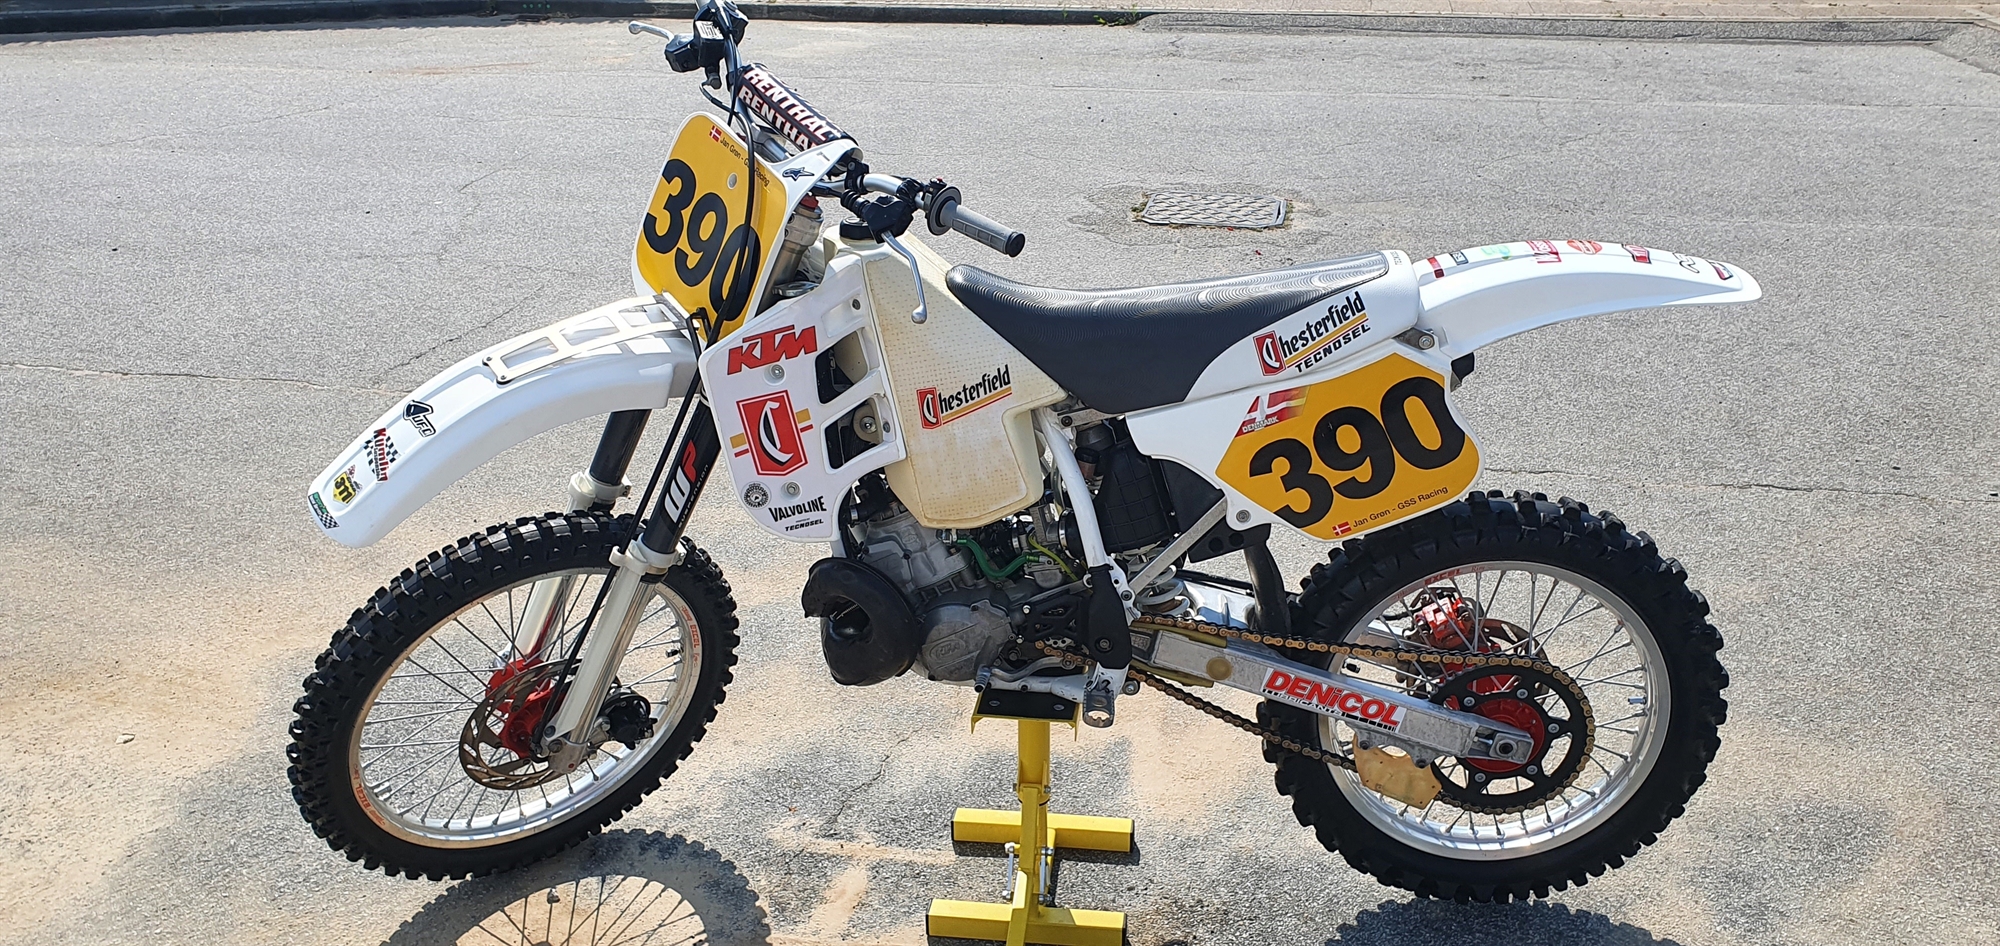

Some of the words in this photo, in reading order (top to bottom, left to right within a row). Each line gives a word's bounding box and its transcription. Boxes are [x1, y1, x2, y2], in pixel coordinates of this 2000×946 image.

[738, 85, 820, 153] RENTHA
[743, 66, 831, 142] RENTHAL
[643, 158, 761, 322] 390
[727, 324, 818, 376] KTM
[1261, 290, 1367, 370] Chesterfield
[1295, 323, 1371, 373] TECNOSEL
[922, 363, 1011, 425] Chesterfield
[373, 427, 389, 481] Kumlin
[664, 439, 697, 524] WP
[1249, 376, 1466, 529] 390
[334, 476, 353, 503] 311
[768, 495, 827, 523] VALVOLINE
[1353, 517, 1369, 528] Jan
[1397, 497, 1417, 510] GSS
[1417, 486, 1449, 503] Racing
[784, 518, 824, 532] TECNOSEL
